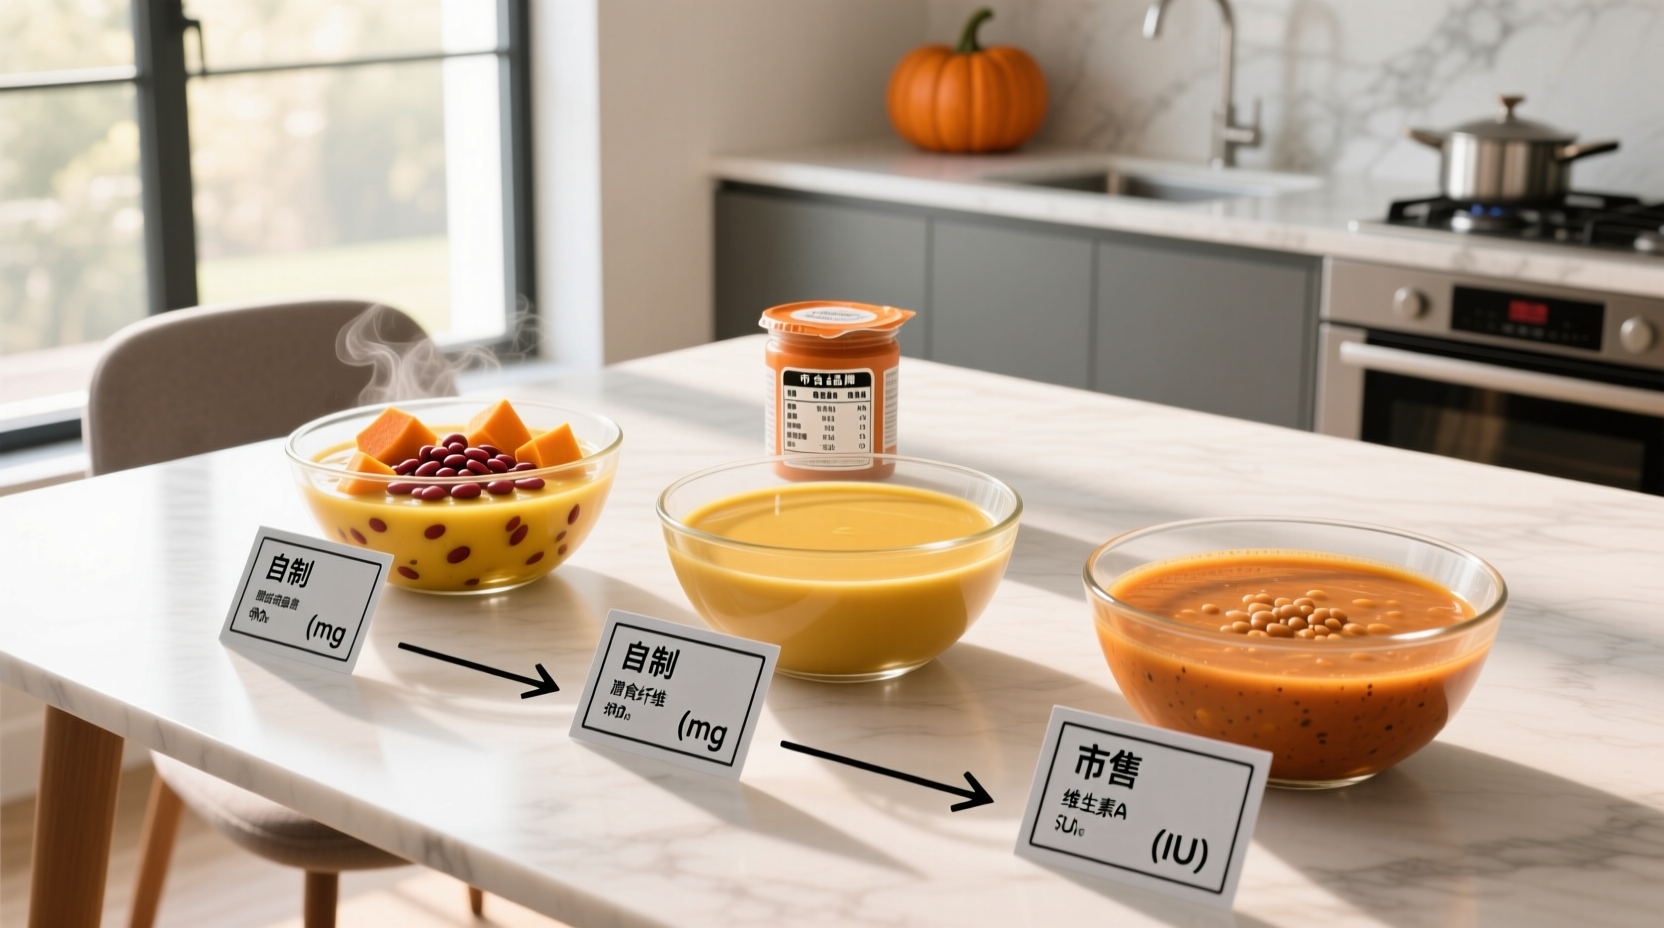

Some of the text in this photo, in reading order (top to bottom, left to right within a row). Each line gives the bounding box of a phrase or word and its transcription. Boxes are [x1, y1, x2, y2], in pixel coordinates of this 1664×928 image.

[266, 553, 315, 588] 自制
[306, 614, 346, 649] (mg
[622, 641, 680, 680] 自制
[677, 710, 728, 752] (mg
[1075, 743, 1142, 790] 市售
[1151, 828, 1208, 875] (IU)
